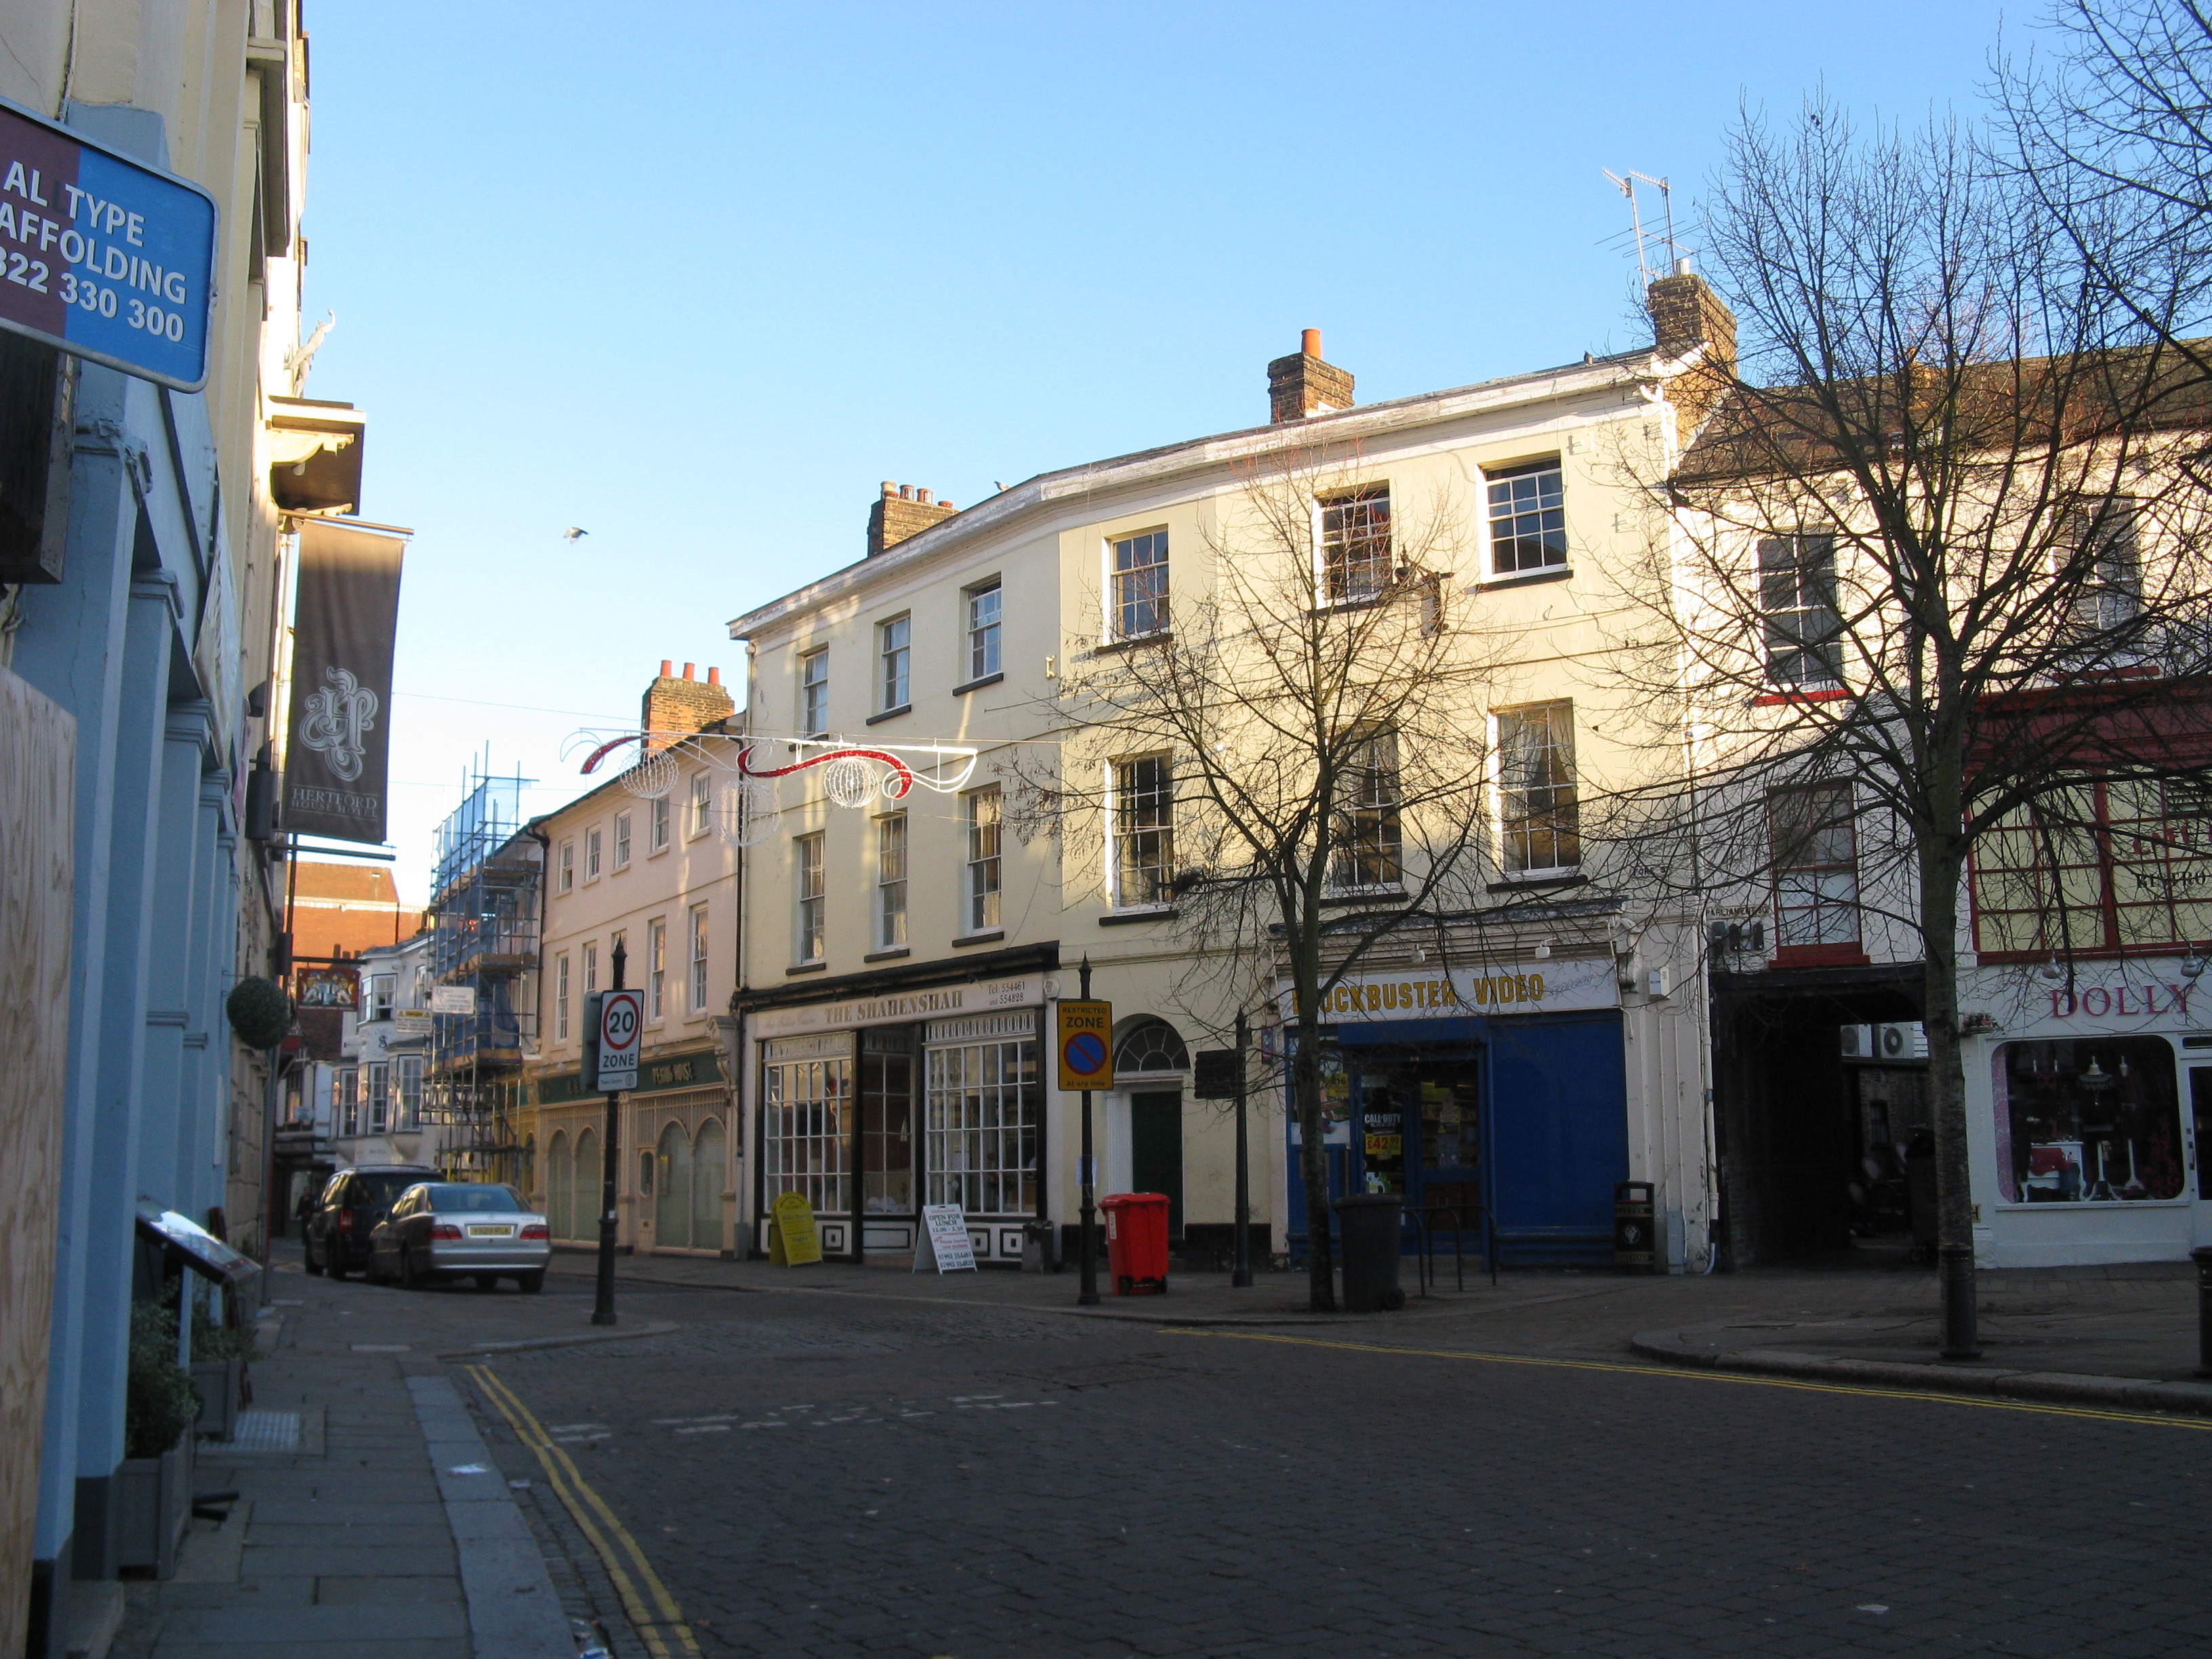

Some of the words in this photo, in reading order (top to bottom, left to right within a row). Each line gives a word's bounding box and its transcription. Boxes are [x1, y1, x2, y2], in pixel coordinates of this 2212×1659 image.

[65, 184, 145, 247] TYPE
[60, 272, 117, 319] 330
[127, 299, 184, 342] 300
[293, 788, 377, 808] HERTFORD
[292, 800, 331, 811] HOUSE
[338, 805, 377, 817] HOTEL
[1002, 981, 1025, 993] 554461
[1293, 980, 1456, 1015] OCKBUSTER
[1473, 974, 1544, 1005] VIDEO
[1000, 992, 1024, 1004] 554828
[2049, 983, 2196, 1017] DOLLY
[609, 1010, 634, 1033] 20
[825, 1006, 853, 1025] THE
[1066, 1017, 1104, 1028] ZONE
[603, 1054, 634, 1068] ZONE
[1364, 1113, 1381, 1124] CALL
[1383, 1113, 1401, 1123] DUTY
